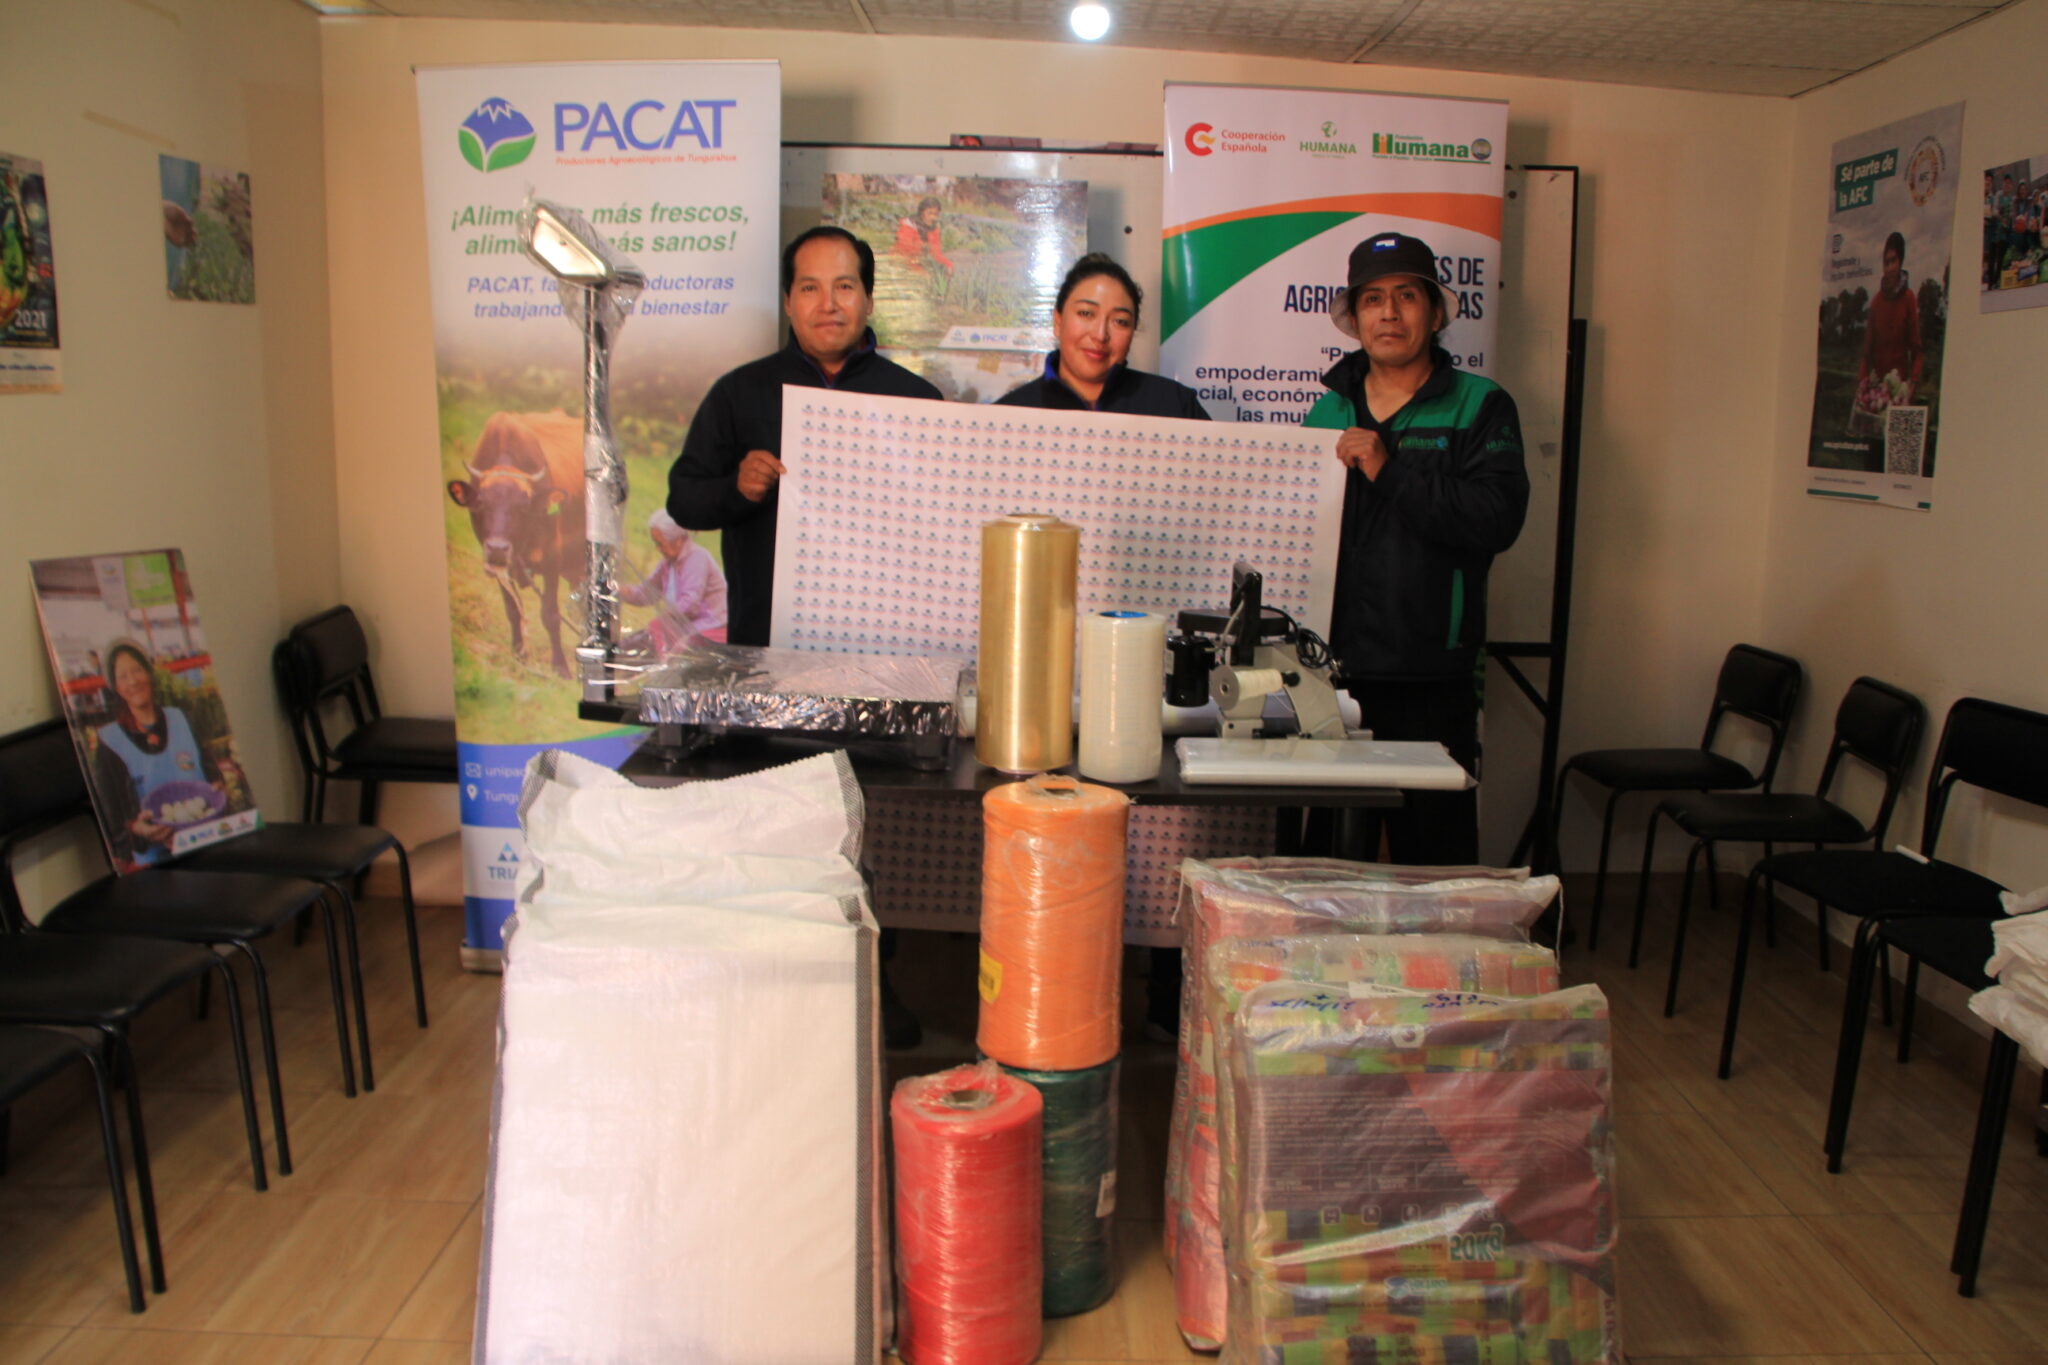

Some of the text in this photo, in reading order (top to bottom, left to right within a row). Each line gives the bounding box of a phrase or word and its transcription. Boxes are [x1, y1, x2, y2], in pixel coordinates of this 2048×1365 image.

[554, 99, 737, 152] PACAT
[1221, 128, 1286, 142] Cooperación
[1221, 141, 1268, 153] Española
[1299, 141, 1357, 155] HUMANA
[1372, 132, 1470, 159] Humana
[555, 156, 606, 166] Productores
[1853, 159, 1880, 182] parte
[1881, 153, 1895, 172] de
[592, 202, 643, 225] más
[649, 201, 749, 226] frescos,
[651, 230, 737, 253] sanos!
[1458, 257, 1485, 286] DE
[467, 276, 534, 294] PACAT,
[14, 309, 47, 329] 2021
[474, 301, 563, 321] trabajand
[641, 299, 729, 316] bienestar
[1467, 351, 1484, 368] el
[1195, 365, 1323, 384] empoderami
[1193, 385, 1238, 404] cial,
[1237, 406, 1264, 422] las
